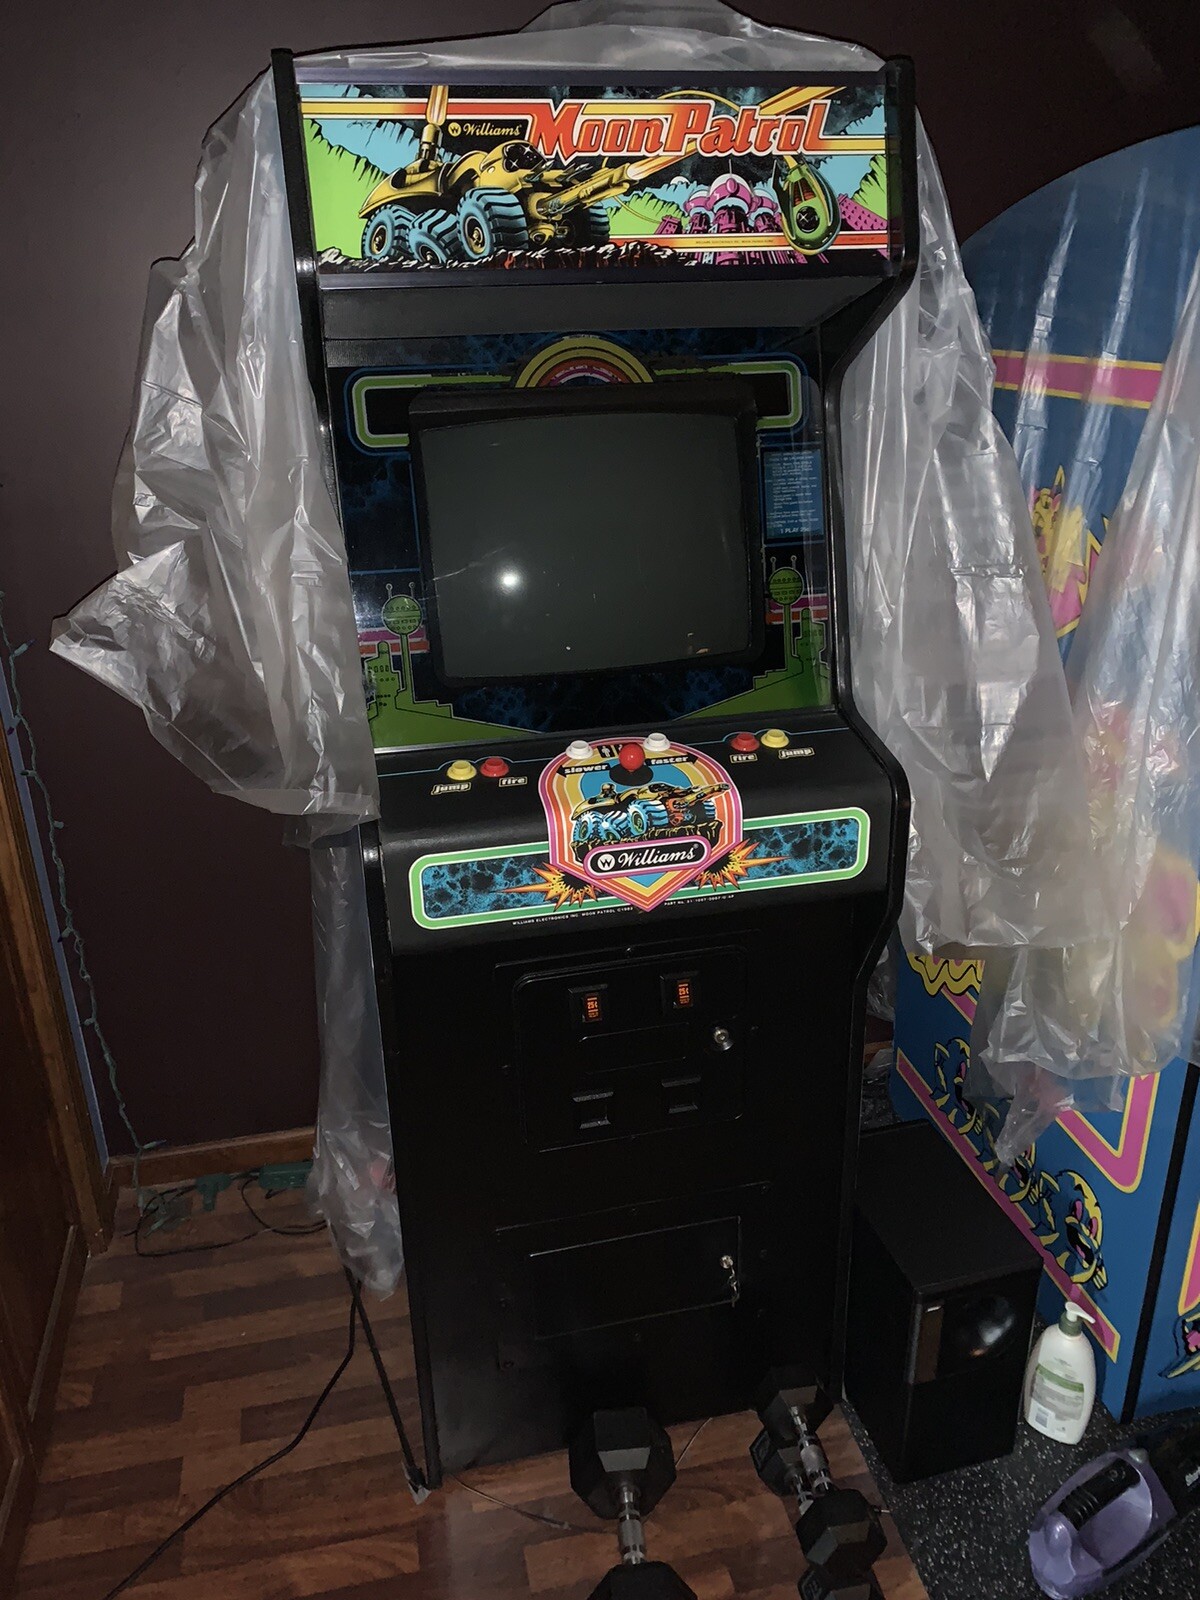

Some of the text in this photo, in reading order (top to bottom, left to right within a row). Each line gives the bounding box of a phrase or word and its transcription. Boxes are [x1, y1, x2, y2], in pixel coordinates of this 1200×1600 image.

[463, 122, 520, 137] Williams
[526, 97, 836, 164] Moon Patrol
[731, 754, 756, 762] fire
[780, 748, 812, 758] jump
[650, 755, 690, 766] faster
[564, 764, 609, 775] slower
[501, 777, 526, 786] fire
[432, 782, 470, 795] jump
[618, 848, 696, 868] Williams
[512, 918, 535, 926] WILLIAMS
[535, 914, 569, 923] ELECTRONICS
[597, 907, 616, 915] PATROL
